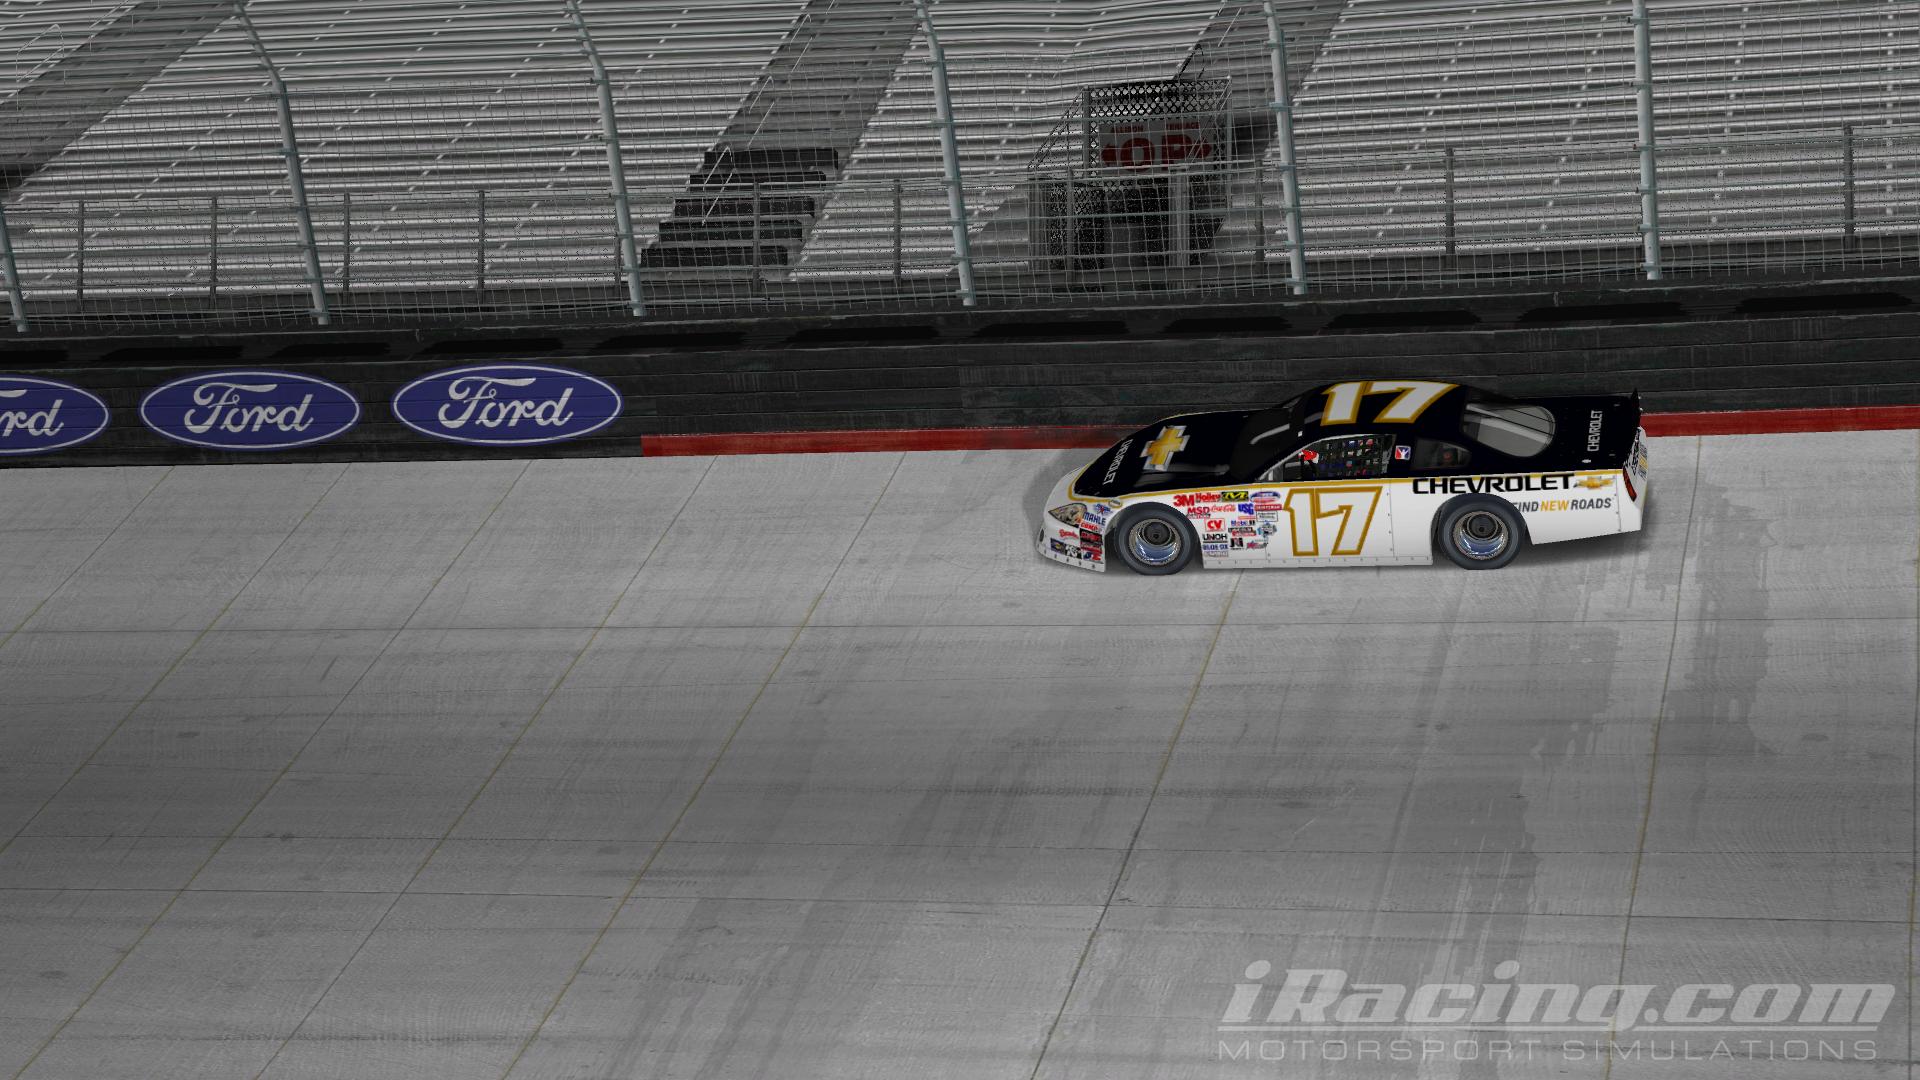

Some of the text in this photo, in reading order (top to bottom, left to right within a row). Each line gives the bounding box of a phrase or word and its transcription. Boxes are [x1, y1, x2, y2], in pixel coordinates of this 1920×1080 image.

[0, 390, 65, 437] rd
[184, 382, 314, 434] Ford
[438, 376, 575, 428] Ford
[1321, 380, 1460, 426] 17
[1586, 410, 1603, 452] CHEVROLET
[1173, 494, 1196, 507] 3M
[1412, 473, 1575, 494] CHEVROLET
[1540, 499, 1569, 512] NEW
[1570, 497, 1612, 510] ROADS
[1187, 506, 1211, 515] MSD
[1207, 520, 1222, 529] CV
[1283, 486, 1383, 557] 17
